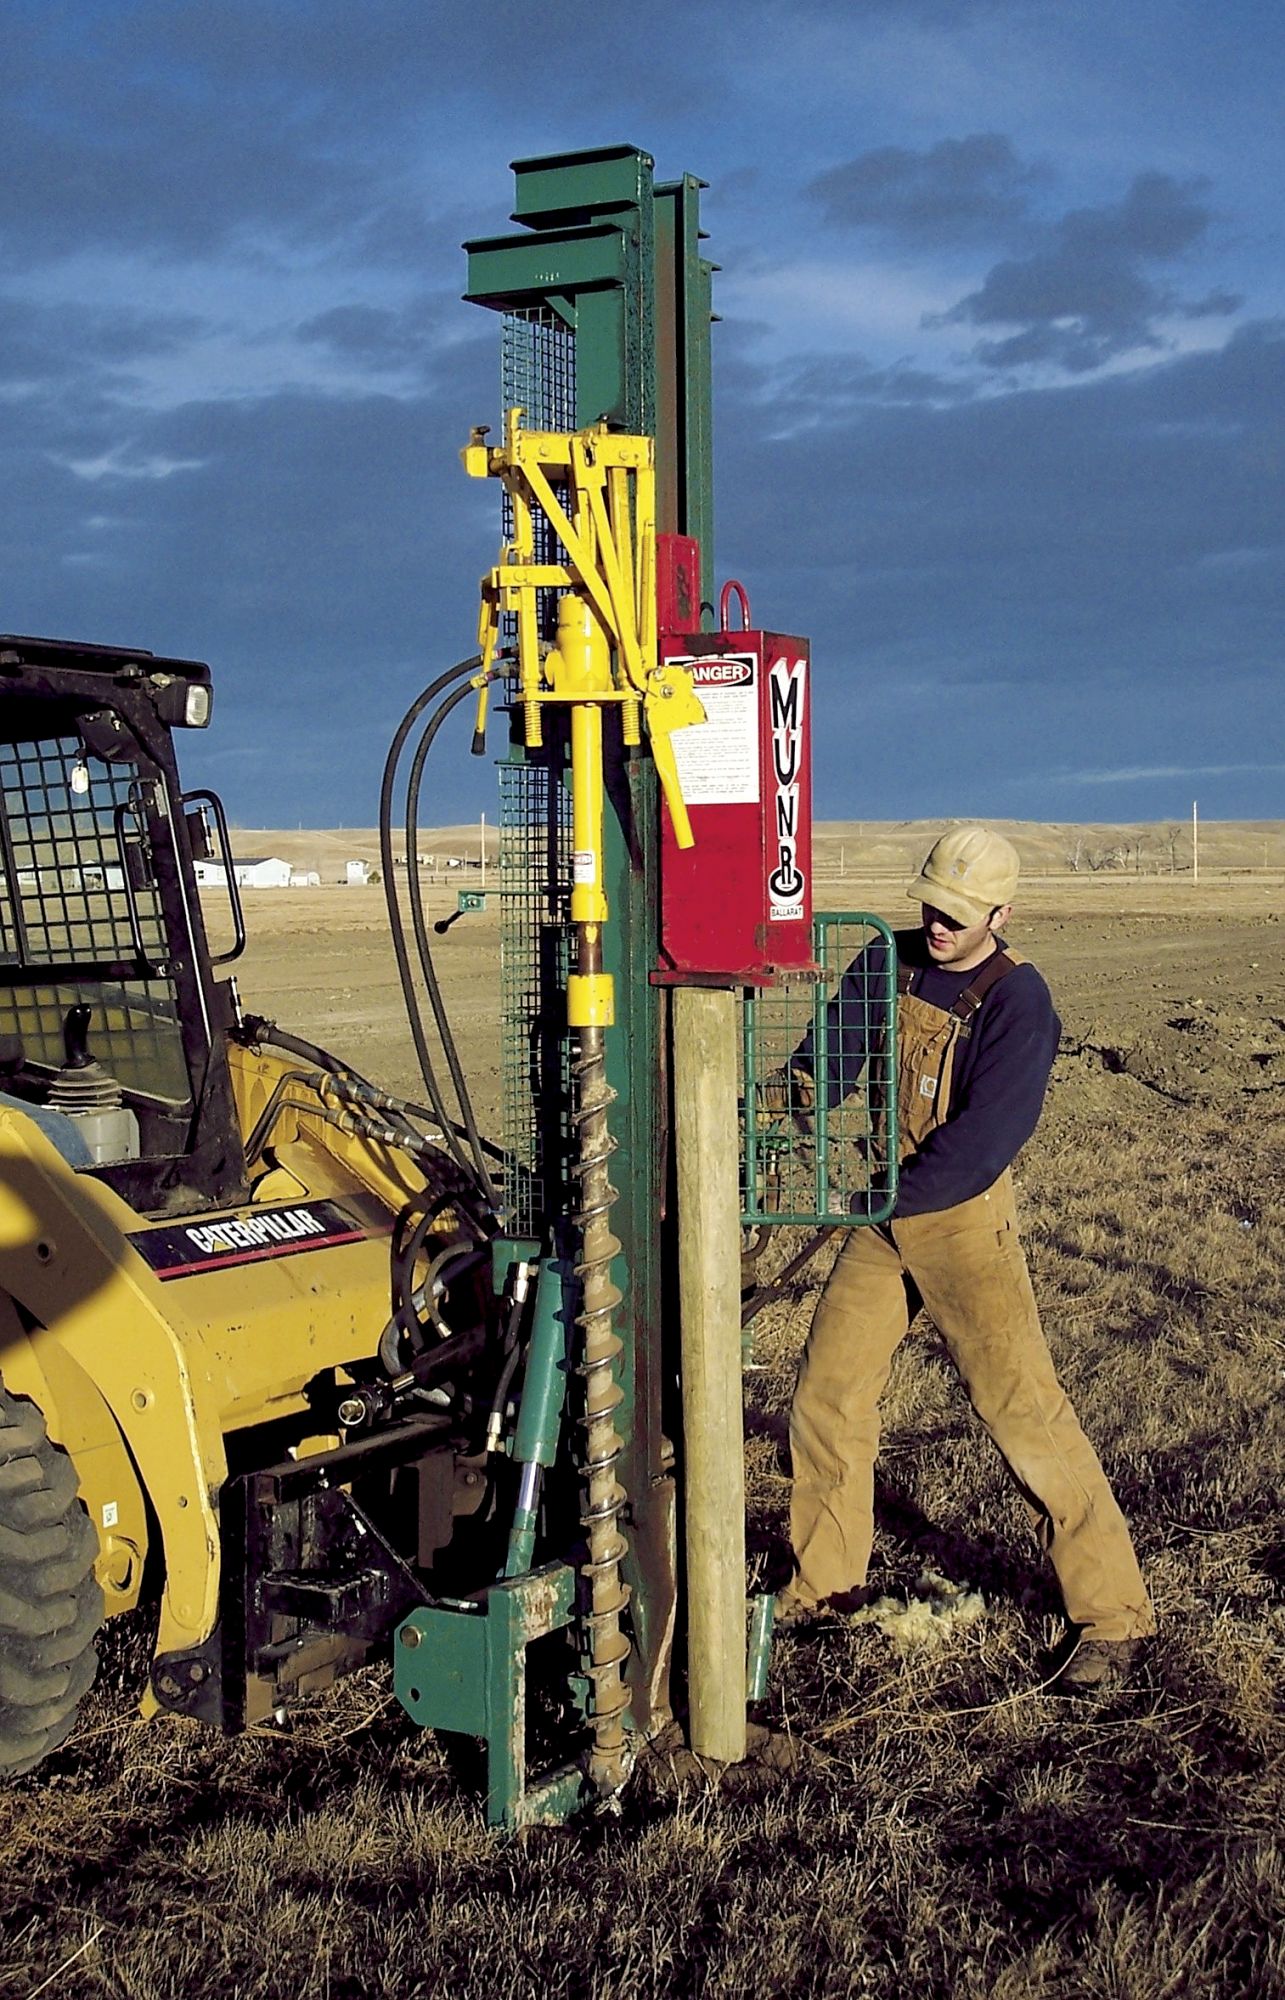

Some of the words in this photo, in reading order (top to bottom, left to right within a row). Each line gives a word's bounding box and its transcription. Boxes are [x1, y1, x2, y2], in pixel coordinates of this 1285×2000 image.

[692, 666, 744, 681] ANGER
[768, 662, 806, 900] MUNRO
[771, 907, 802, 917] BALLARAT
[185, 1209, 326, 1253] CATERPILLAR
